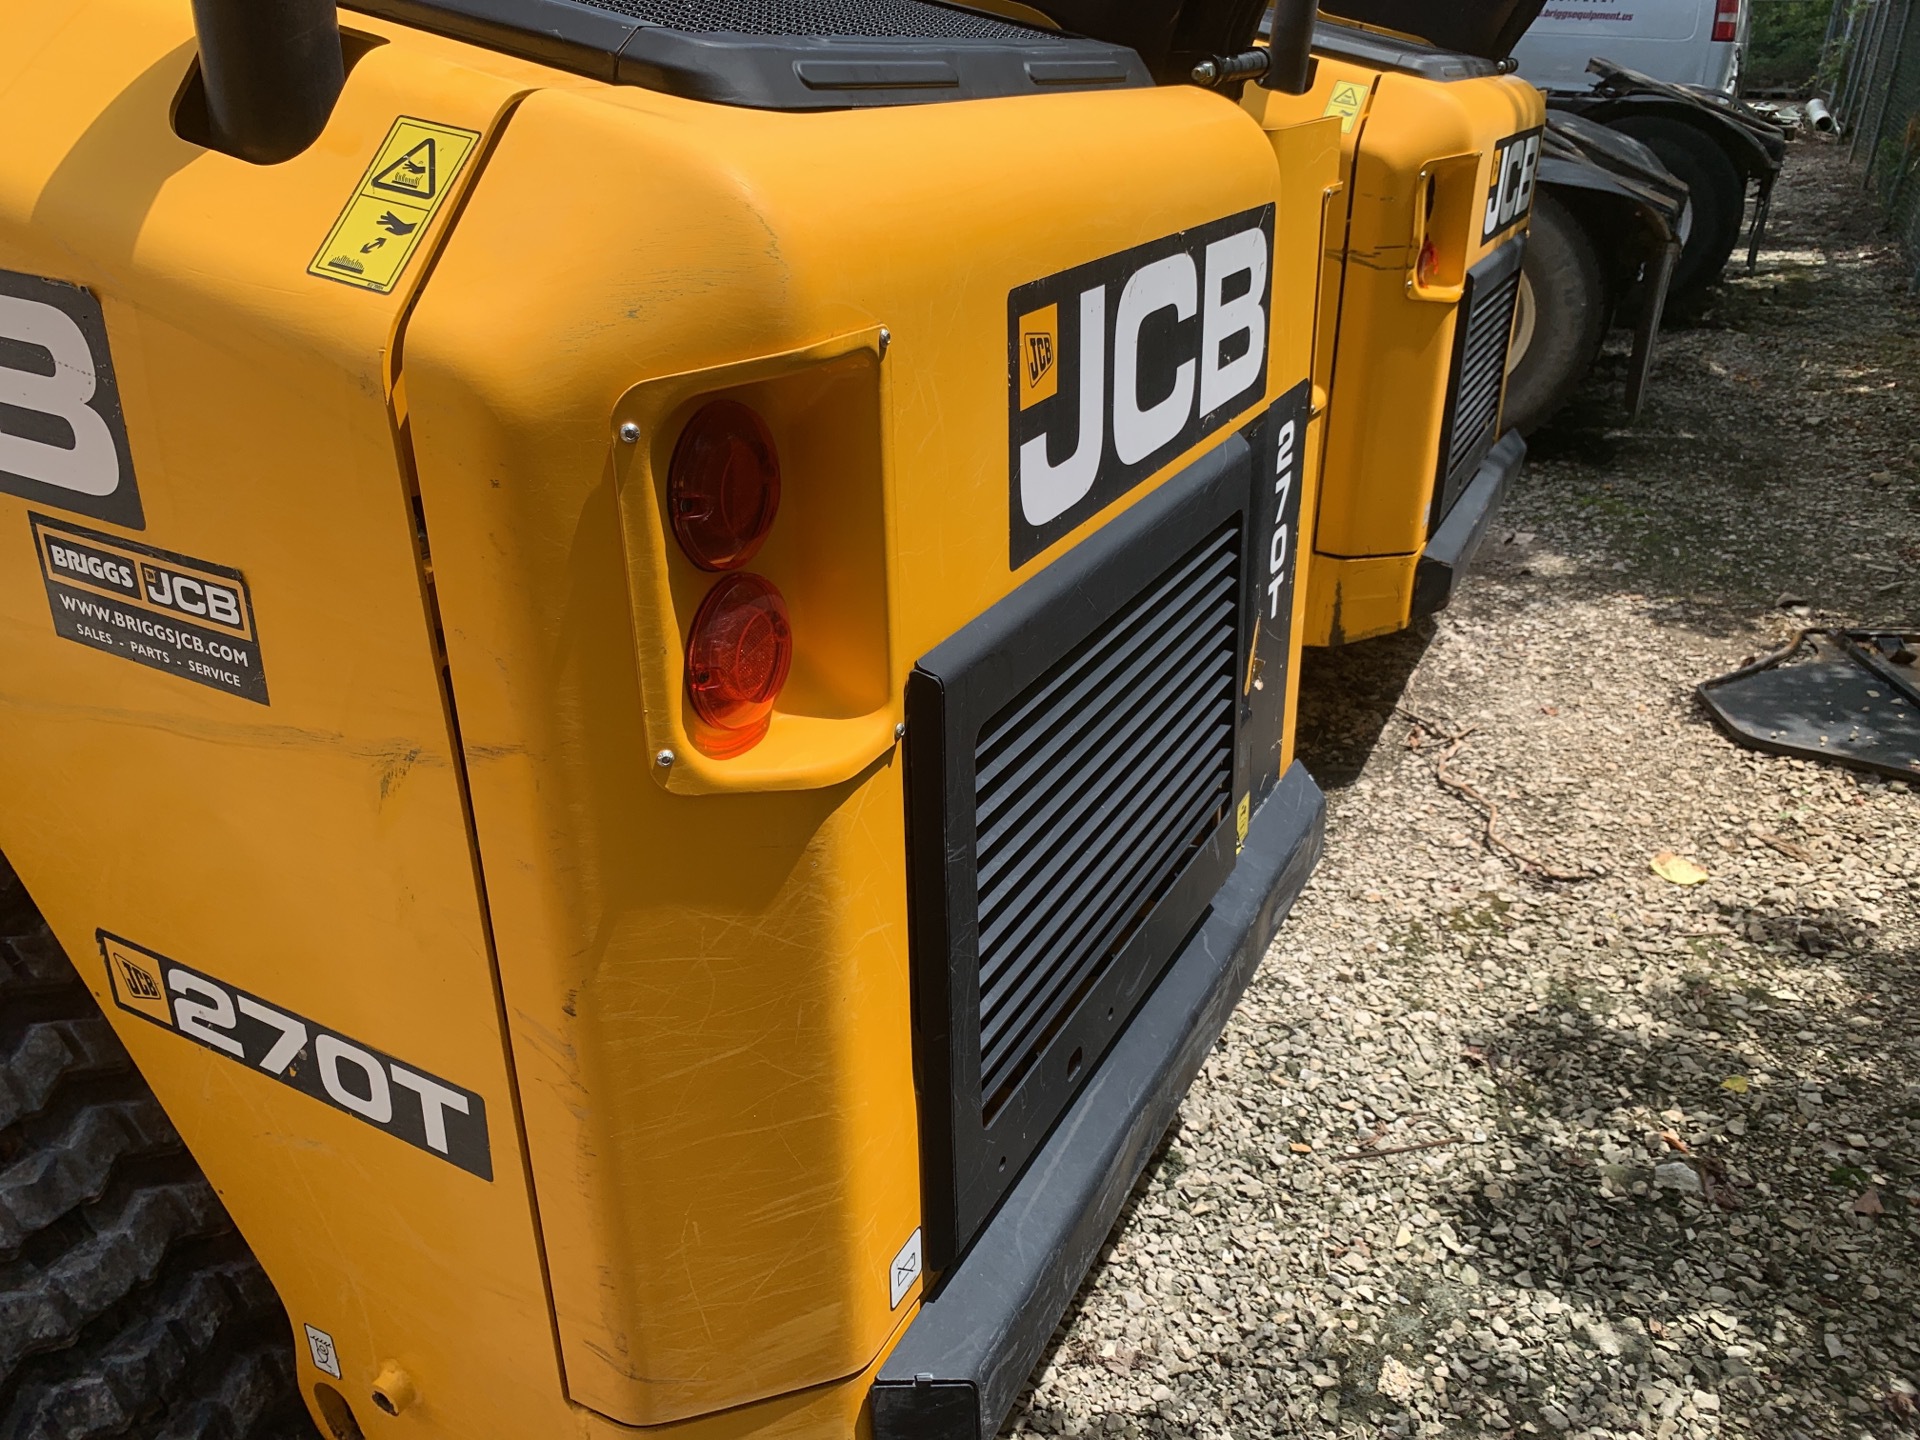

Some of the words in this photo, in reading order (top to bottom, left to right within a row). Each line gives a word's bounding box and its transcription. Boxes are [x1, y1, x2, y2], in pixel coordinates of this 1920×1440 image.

[1484, 135, 1540, 235] JCB
[0, 294, 120, 497] B
[1020, 227, 1268, 526] JCB
[1028, 333, 1054, 379] JCB
[1268, 419, 1295, 620] 270T
[50, 544, 134, 589] BRIGGS
[147, 572, 240, 625] JCB
[58, 592, 249, 668] WWW.BRIGGSJCB.COM
[76, 623, 113, 646] SALES
[130, 640, 171, 664] PARTS
[188, 659, 242, 688] SERVICE
[122, 960, 160, 998] JCB
[167, 967, 470, 1155] 270T
